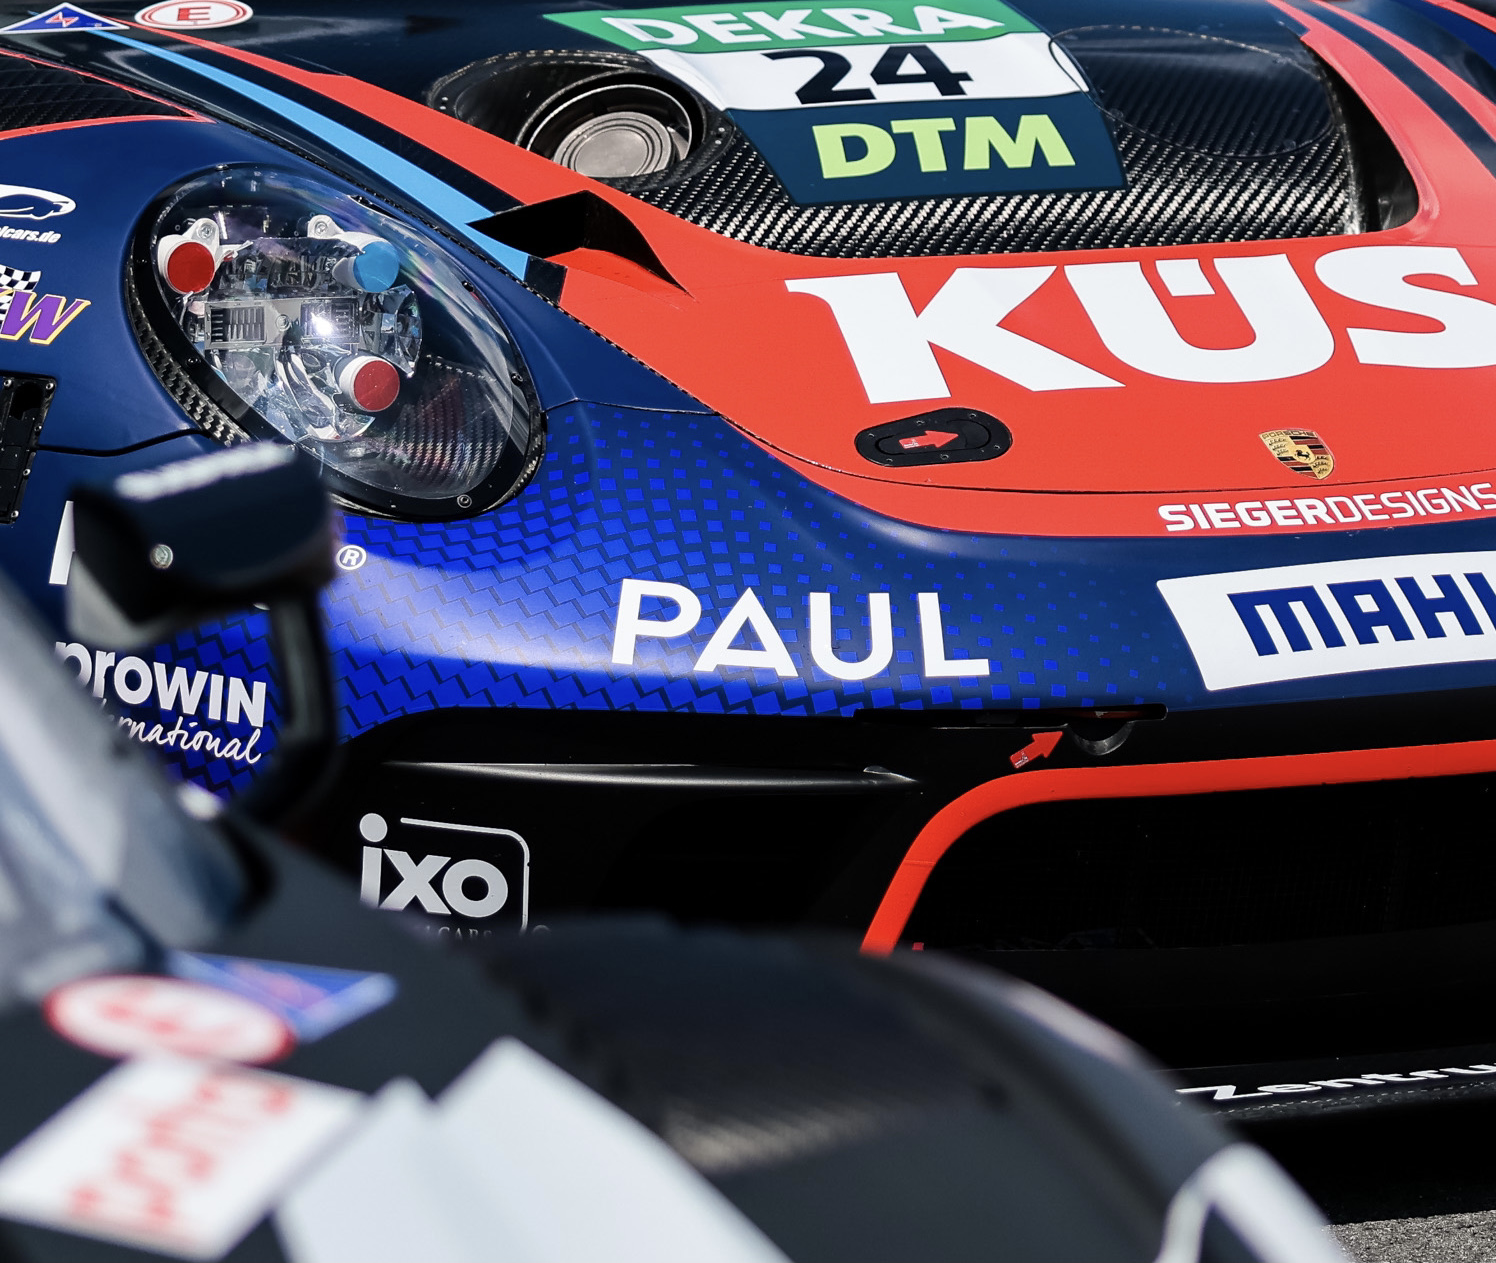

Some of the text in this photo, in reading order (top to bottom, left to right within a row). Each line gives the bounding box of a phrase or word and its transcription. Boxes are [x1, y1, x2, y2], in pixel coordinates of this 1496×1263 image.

[602, 3, 1006, 47] DEKRA
[762, 44, 974, 104] 24
[812, 113, 1077, 179] DTM
[611, 578, 990, 681] PAUL
